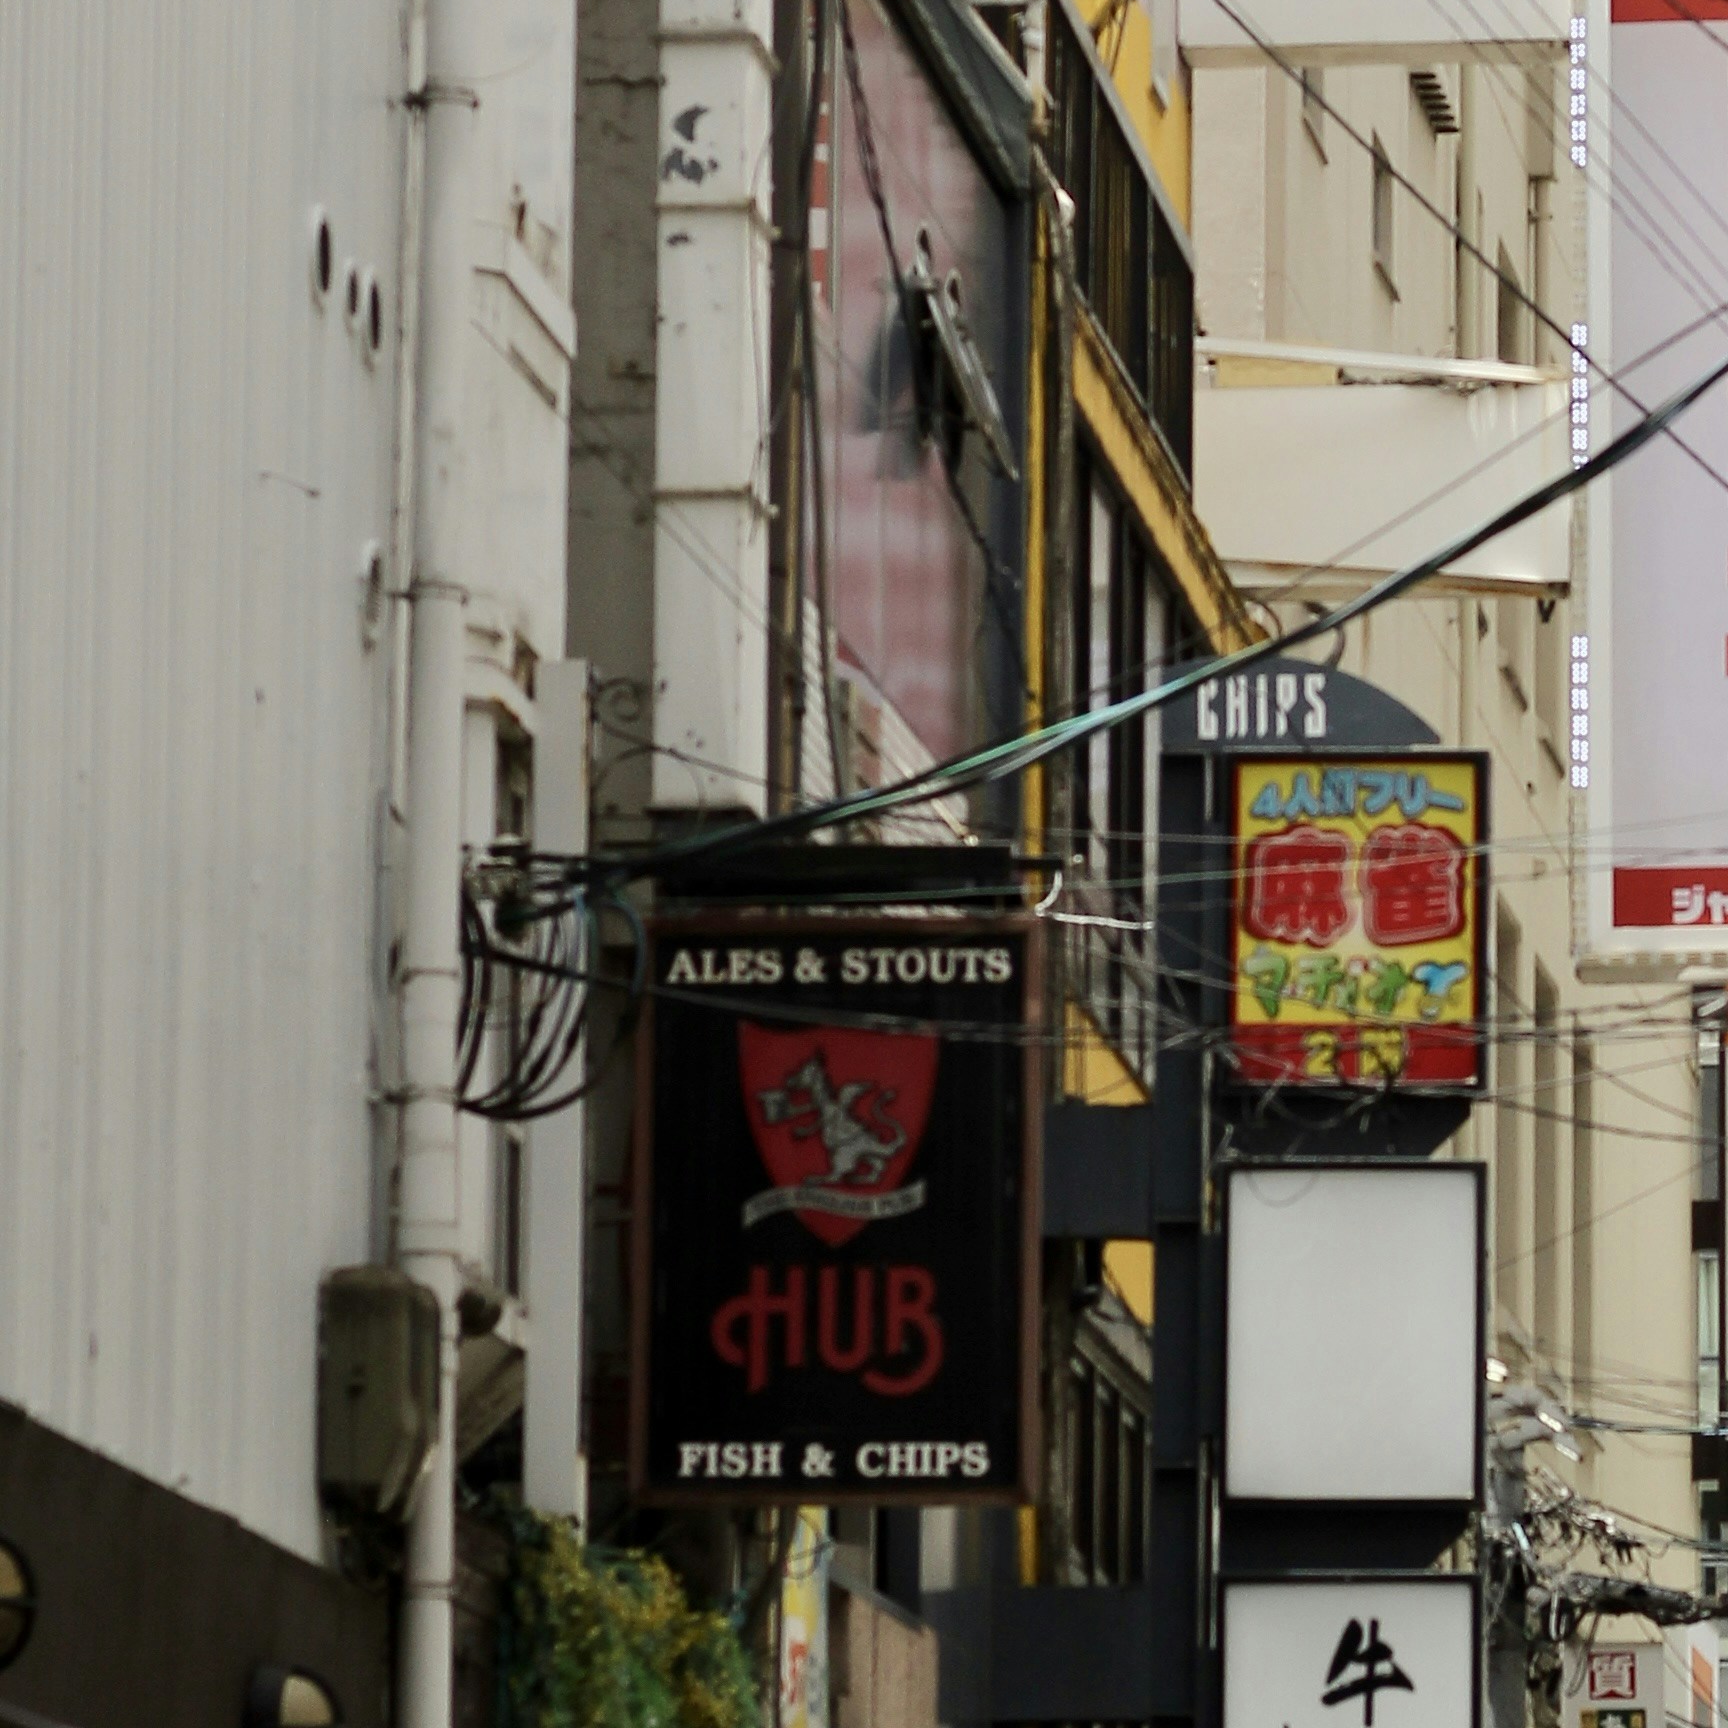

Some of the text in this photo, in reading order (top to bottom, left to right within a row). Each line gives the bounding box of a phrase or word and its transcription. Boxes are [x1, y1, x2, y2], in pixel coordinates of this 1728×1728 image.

[1197, 673, 1328, 741] CHIPS
[668, 947, 1012, 986] ALES & STOUTS
[709, 1262, 944, 1397] HUB
[678, 1441, 989, 1479] FISH & CHIPS
